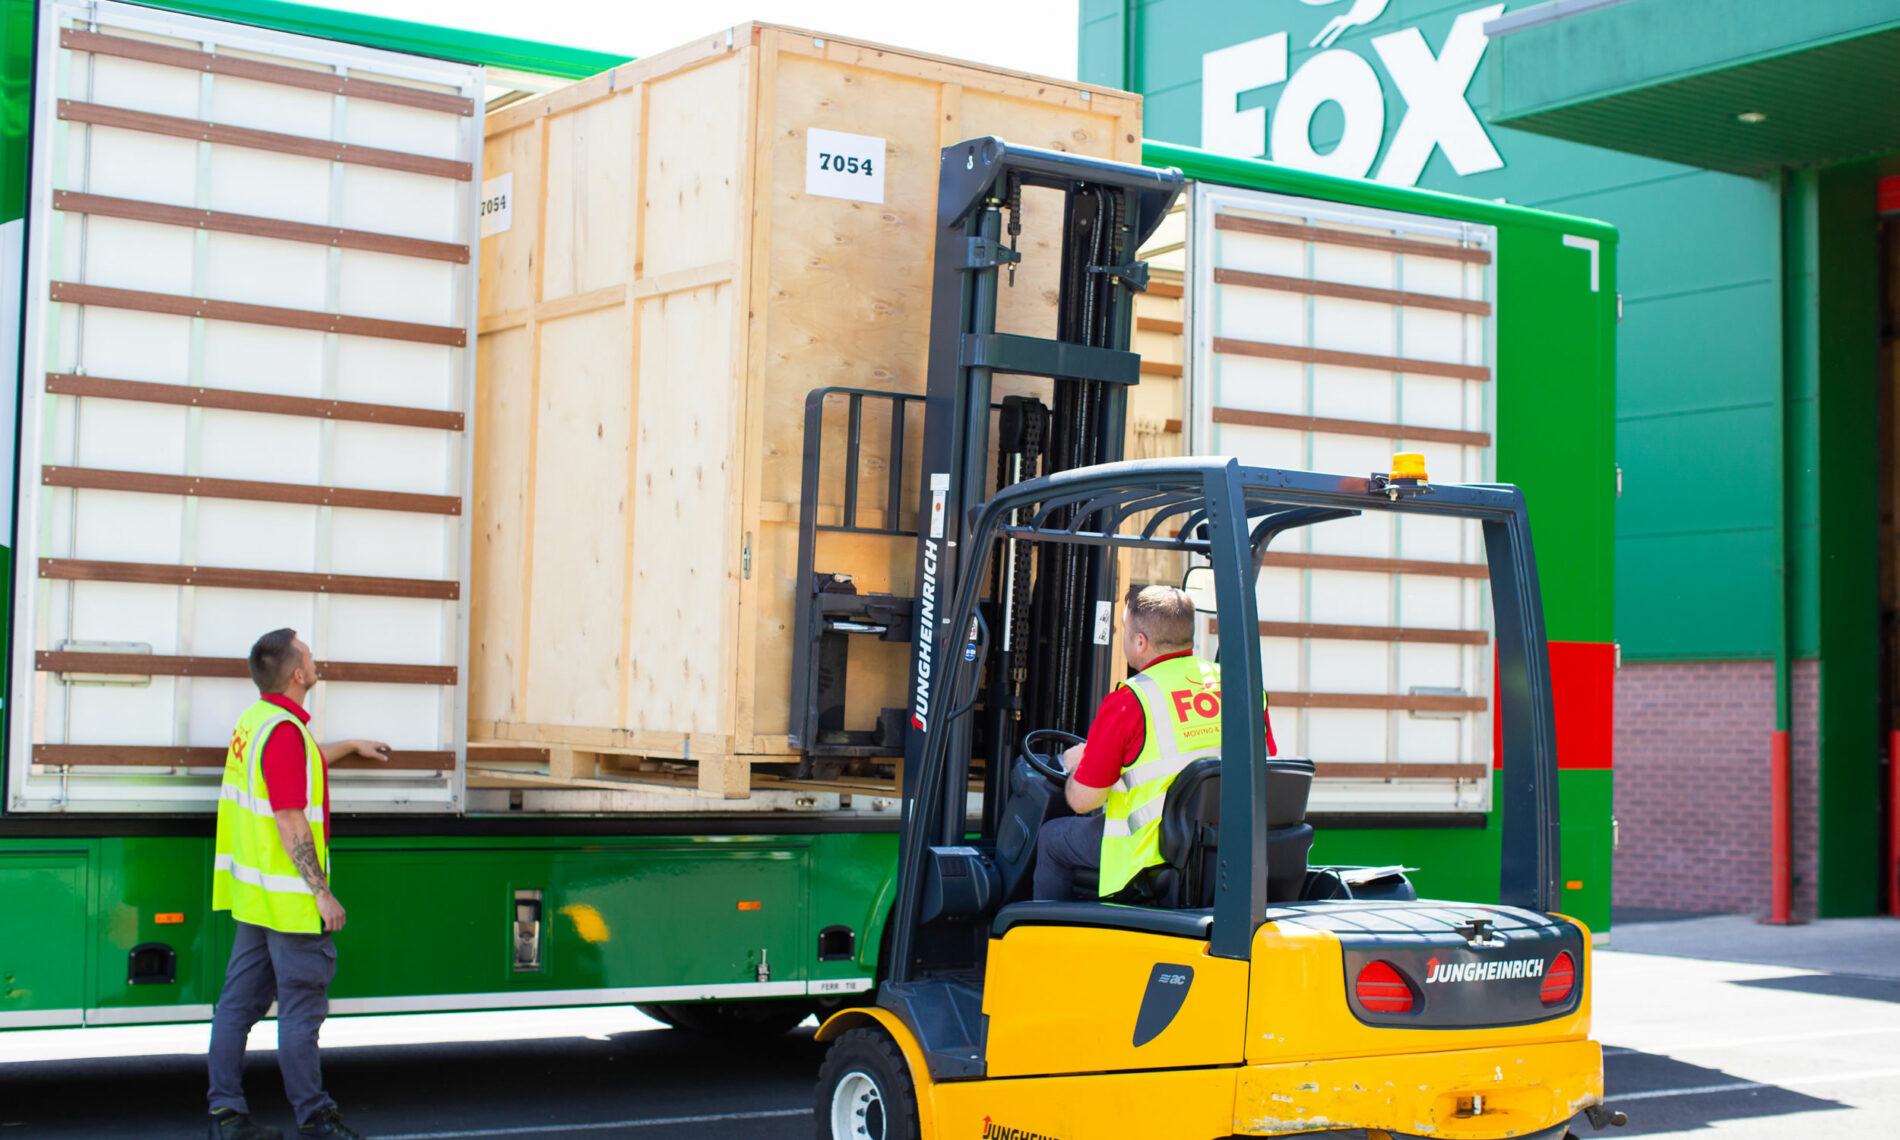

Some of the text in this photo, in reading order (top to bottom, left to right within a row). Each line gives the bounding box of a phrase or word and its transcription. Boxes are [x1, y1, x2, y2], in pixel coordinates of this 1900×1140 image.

[1201, 3, 1507, 187] FOX
[819, 152, 873, 176] 7054
[481, 194, 506, 216] 7054
[913, 539, 939, 733] JUNGHEINRICH
[1170, 689, 1221, 723] FO
[1183, 727, 1214, 738] MOVING
[1425, 958, 1544, 984] JUNGHEINRICH
